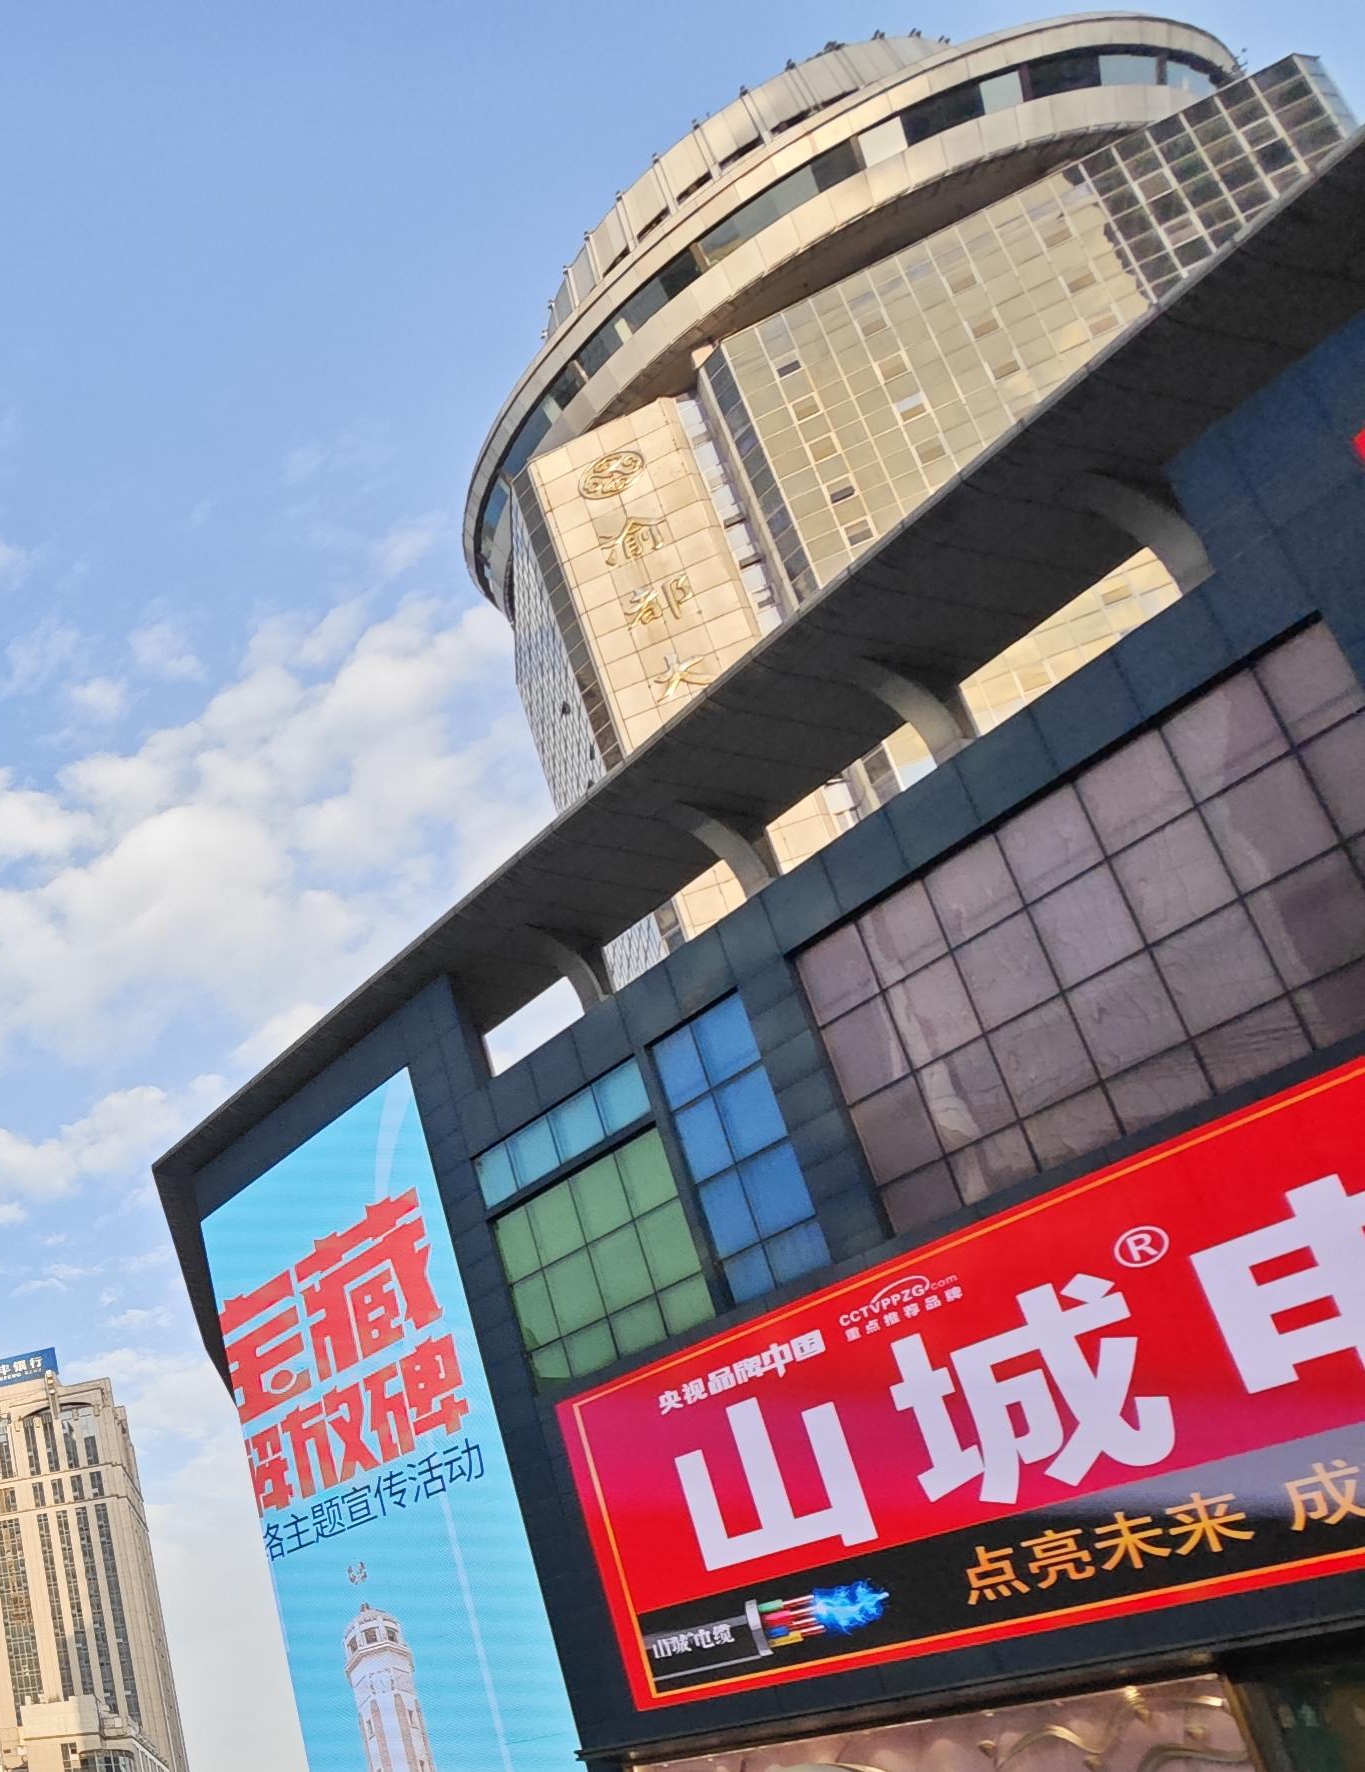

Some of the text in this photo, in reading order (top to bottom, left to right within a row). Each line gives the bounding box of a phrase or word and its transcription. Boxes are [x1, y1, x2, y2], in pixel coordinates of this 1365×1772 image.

[844, 1286, 964, 1343] 重点推荐品牌
[658, 1329, 826, 1415] 央视品牌中国
[965, 1492, 1255, 1606] 点亮未来
